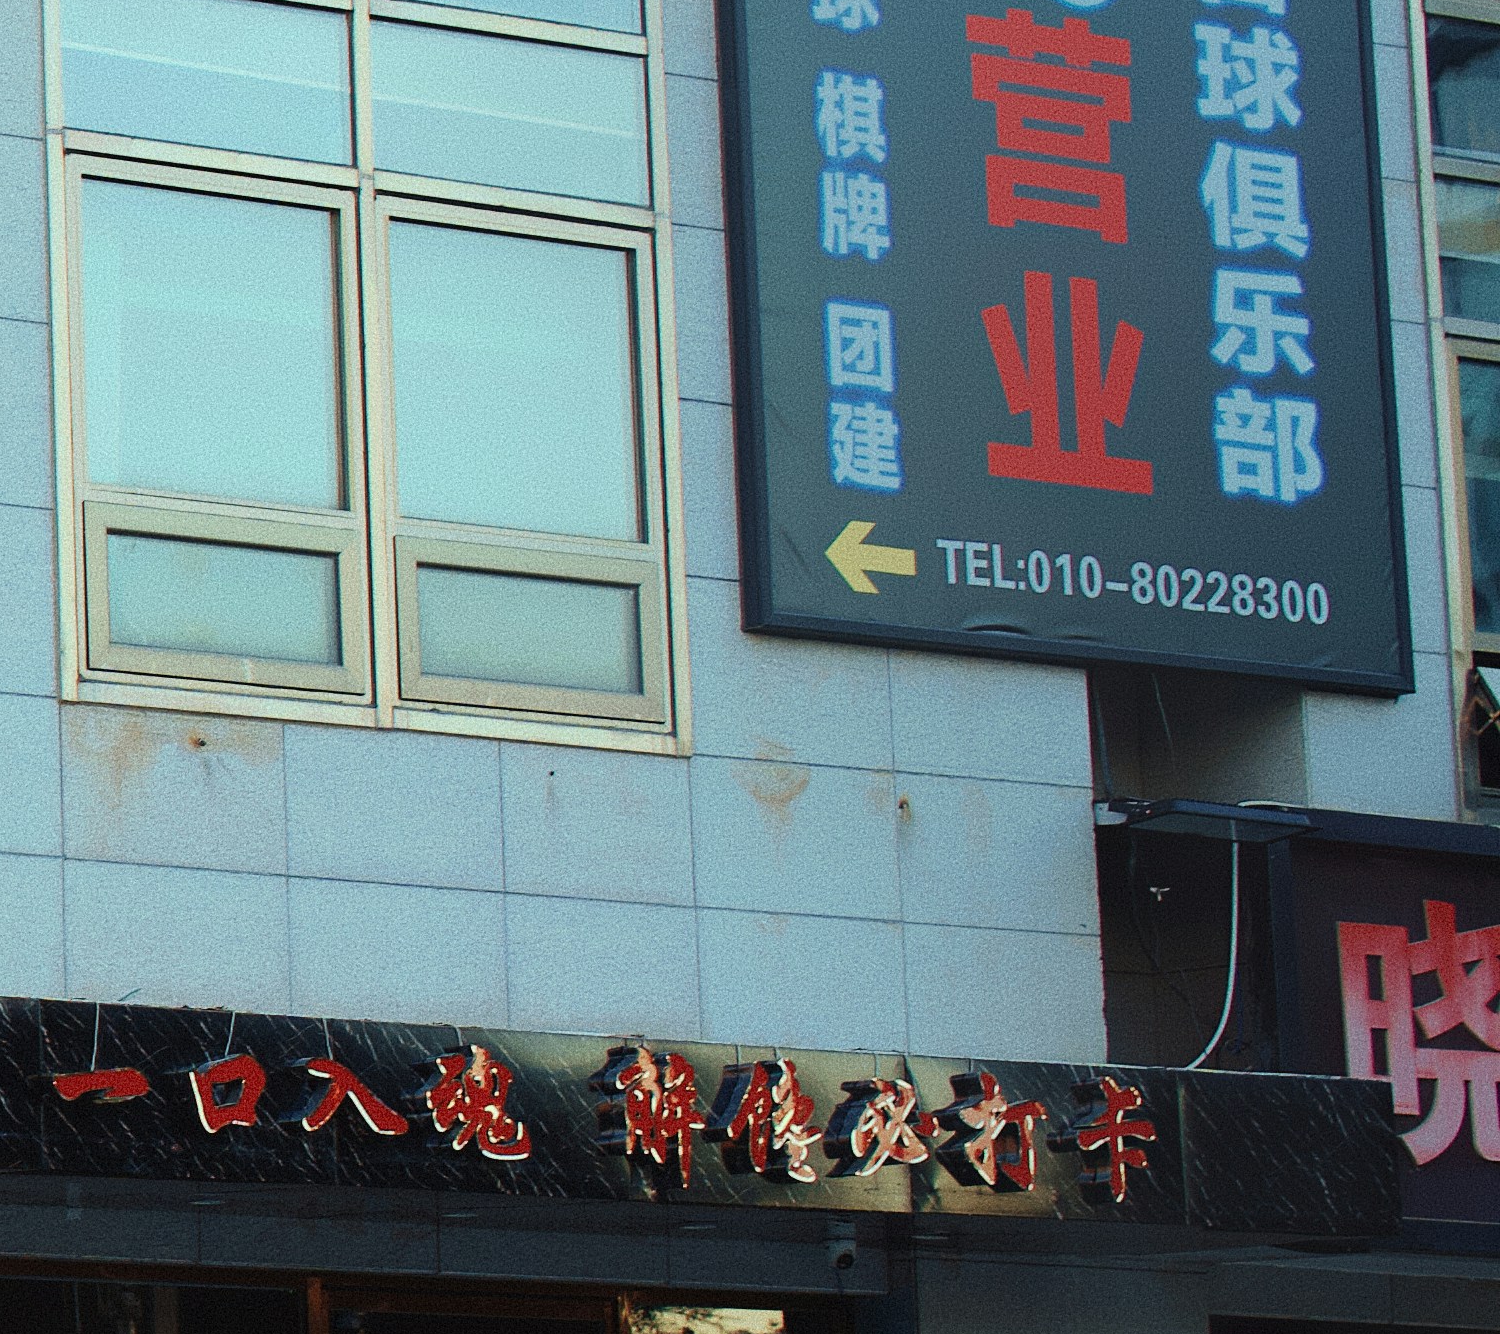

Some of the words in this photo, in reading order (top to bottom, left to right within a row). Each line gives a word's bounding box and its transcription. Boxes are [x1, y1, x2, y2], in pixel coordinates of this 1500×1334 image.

[814, 70, 891, 260] 棋牌
[964, 9, 1154, 495] 营业
[823, 300, 902, 491] 团建
[936, 538, 1330, 627] TEL:010-80228300
[52, 1045, 531, 1162] 一口入魂
[612, 1050, 1157, 1203] 解馋必打卡
